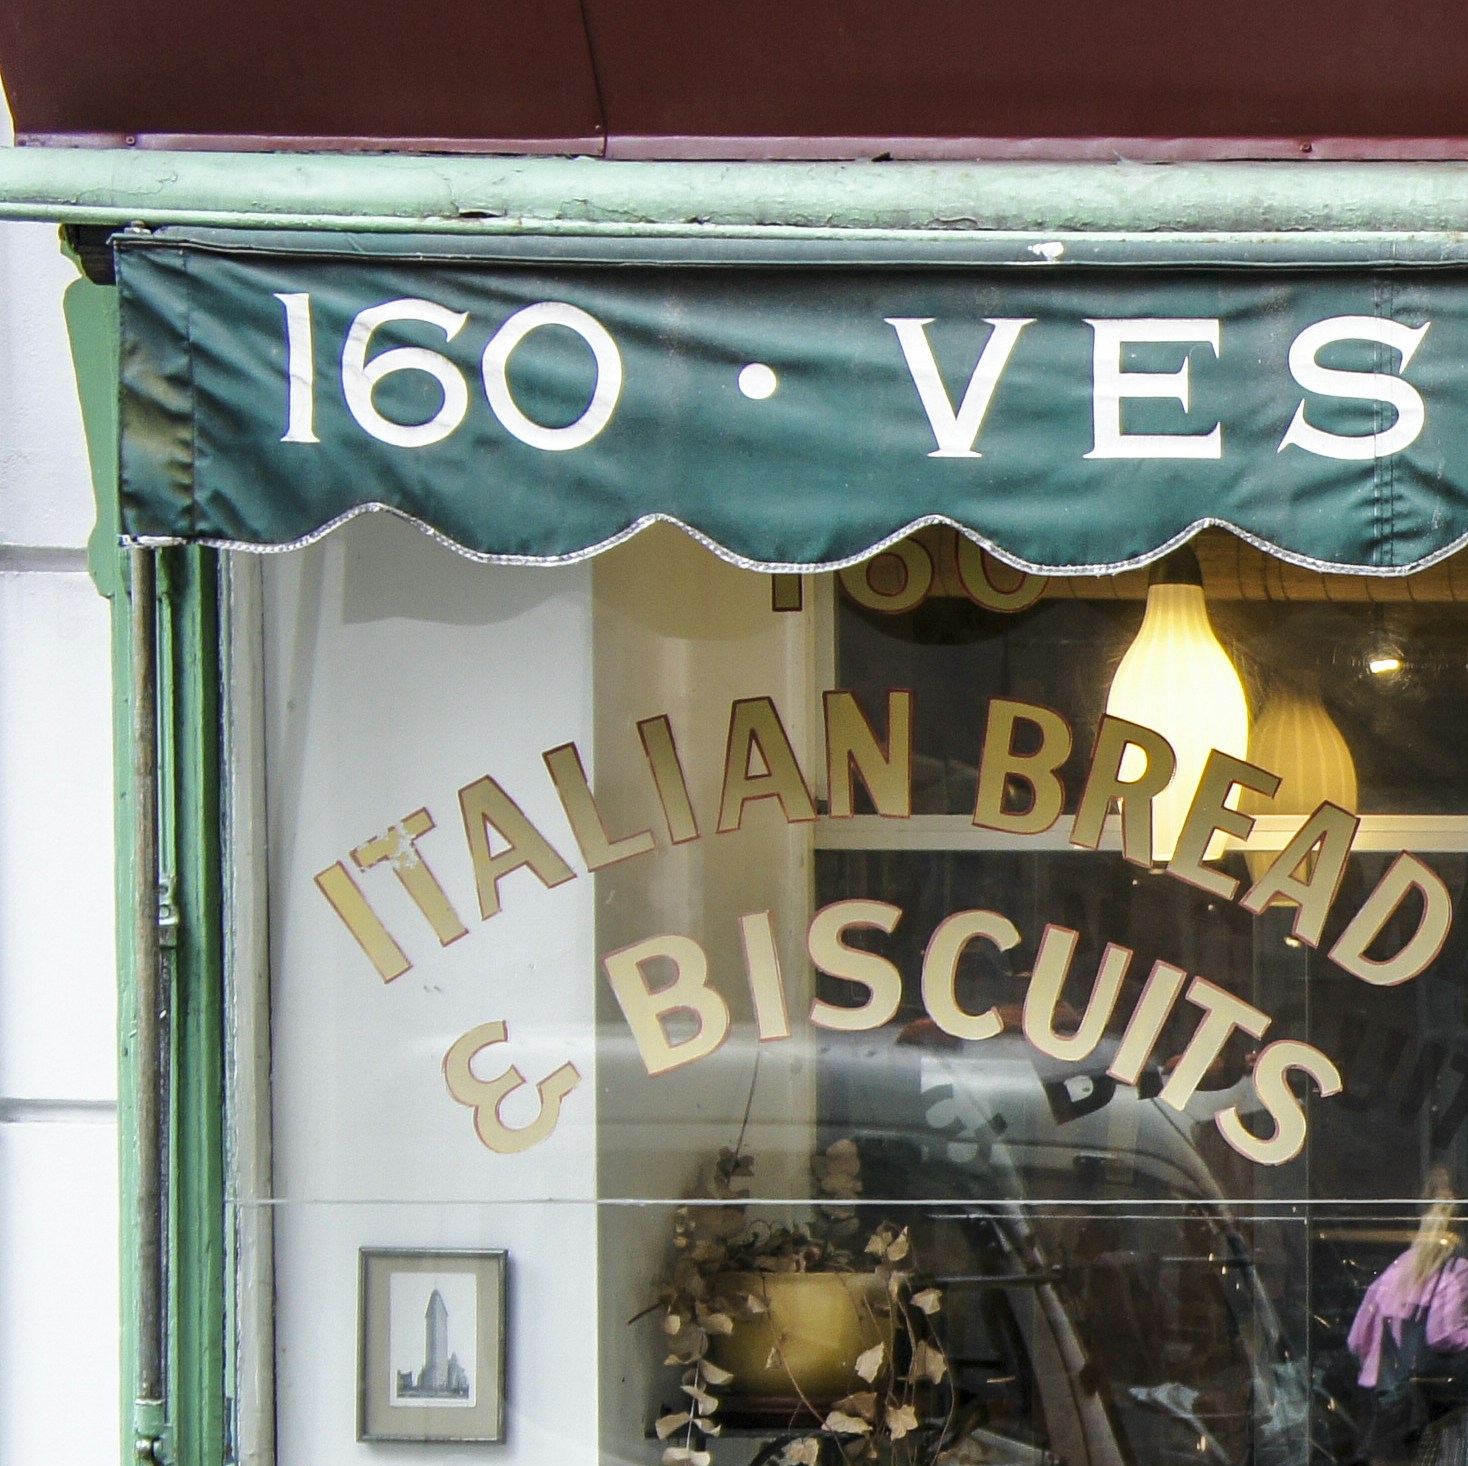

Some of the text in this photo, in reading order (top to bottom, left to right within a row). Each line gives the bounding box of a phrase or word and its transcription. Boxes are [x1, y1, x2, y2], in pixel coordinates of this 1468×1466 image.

[278, 292, 623, 452] 160
[313, 688, 1453, 986] ITALIAN BREAD
[441, 897, 1344, 1166] & BISCUITS
